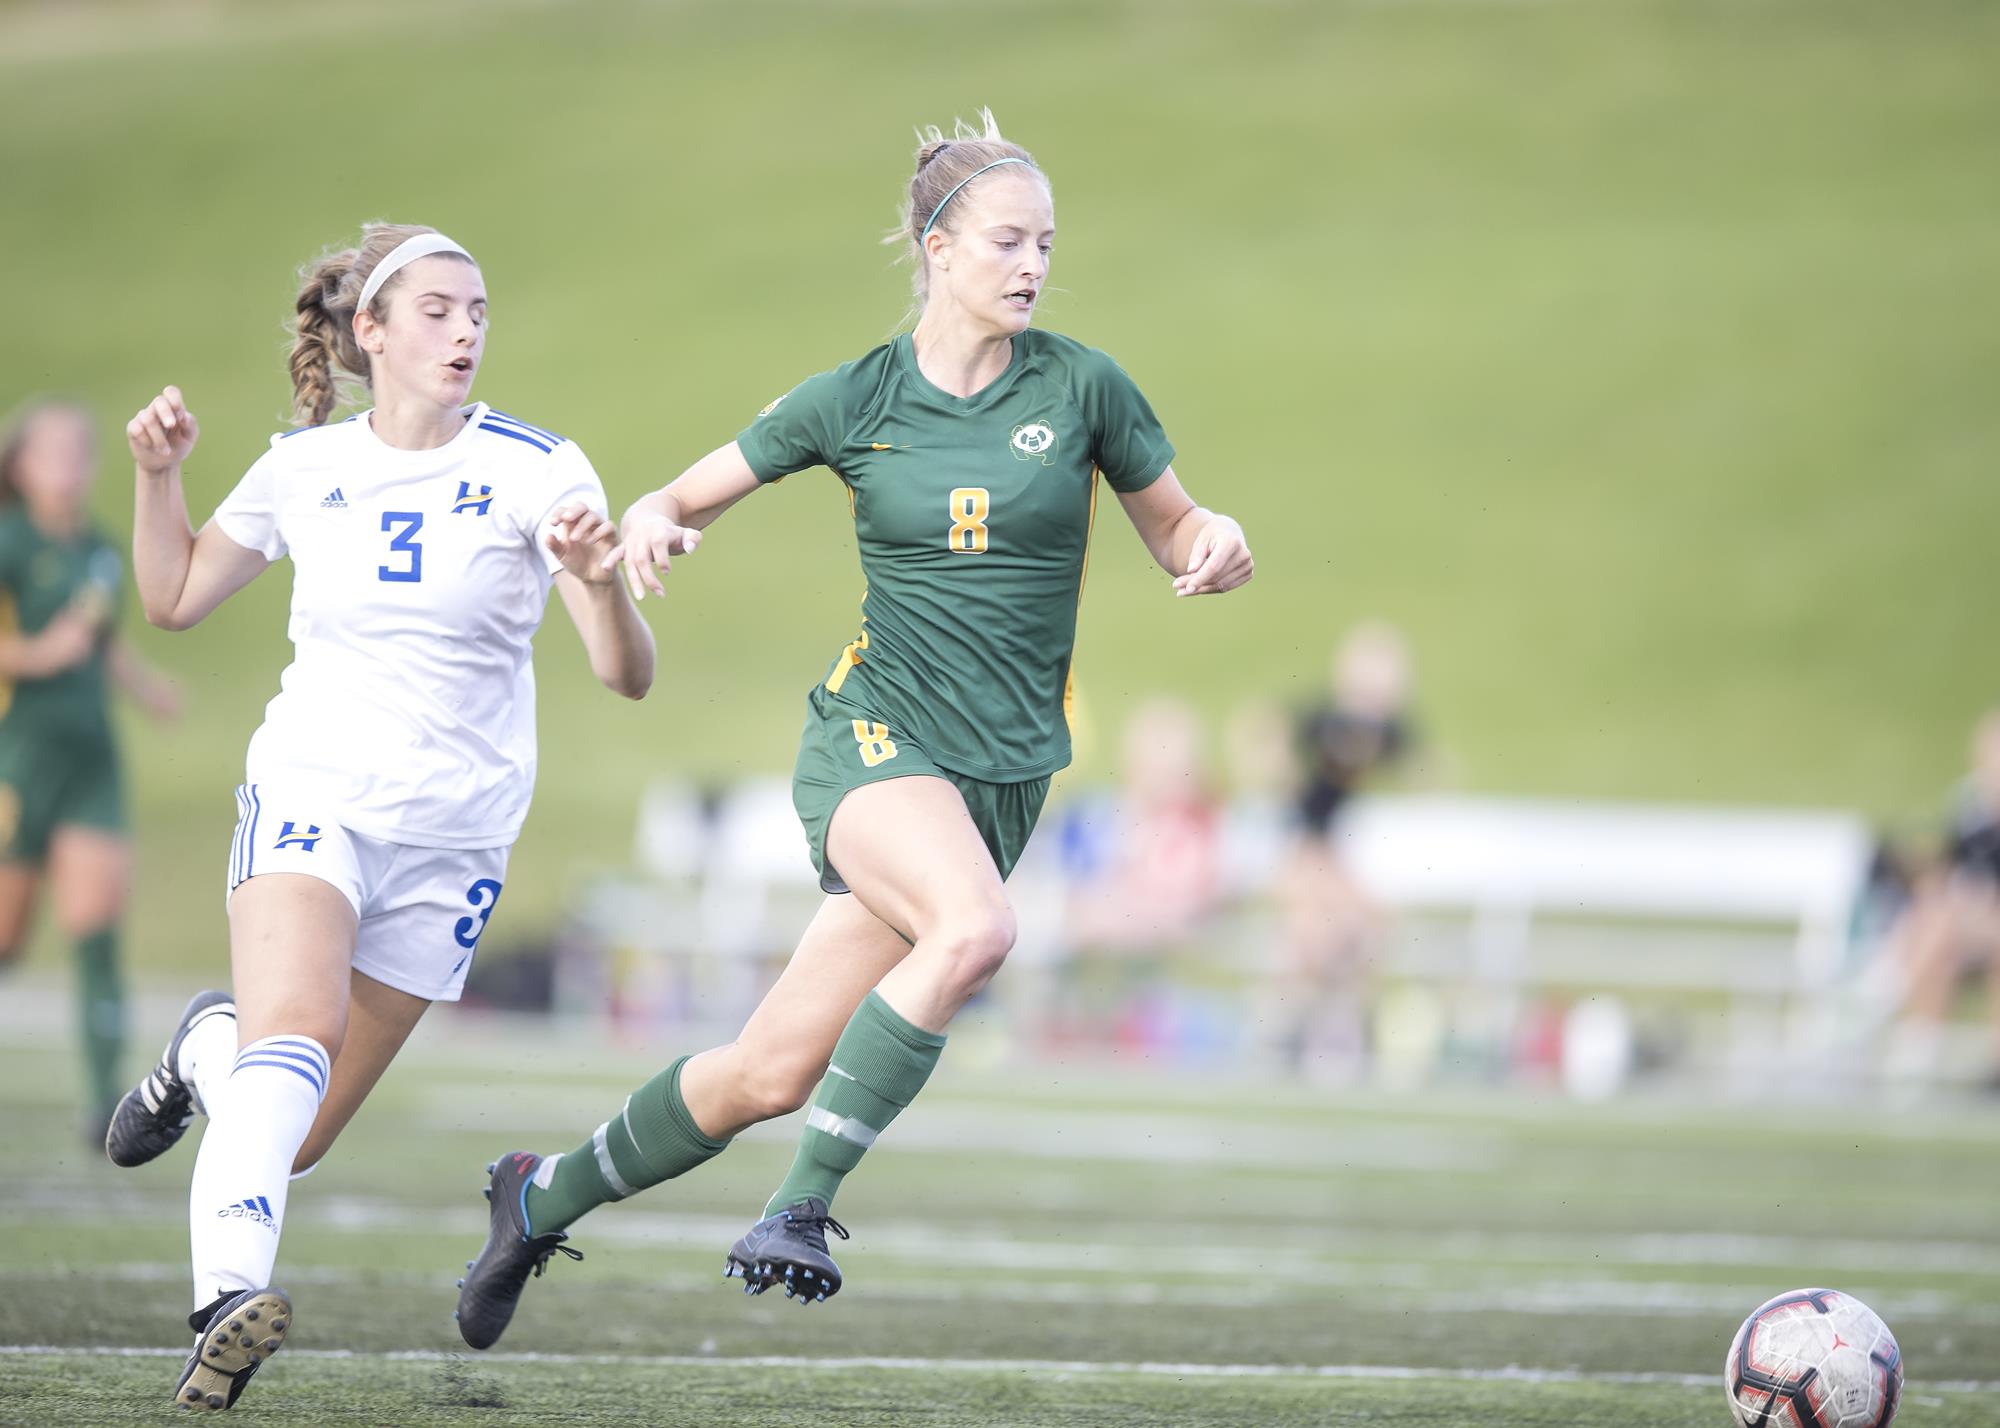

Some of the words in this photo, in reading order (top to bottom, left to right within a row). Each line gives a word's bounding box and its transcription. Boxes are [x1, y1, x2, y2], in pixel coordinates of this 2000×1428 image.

[378, 511, 423, 582] 3
[948, 487, 989, 554] 8
[852, 719, 898, 767] 8
[454, 878, 503, 948] 3
[217, 1208, 278, 1234] adidas
